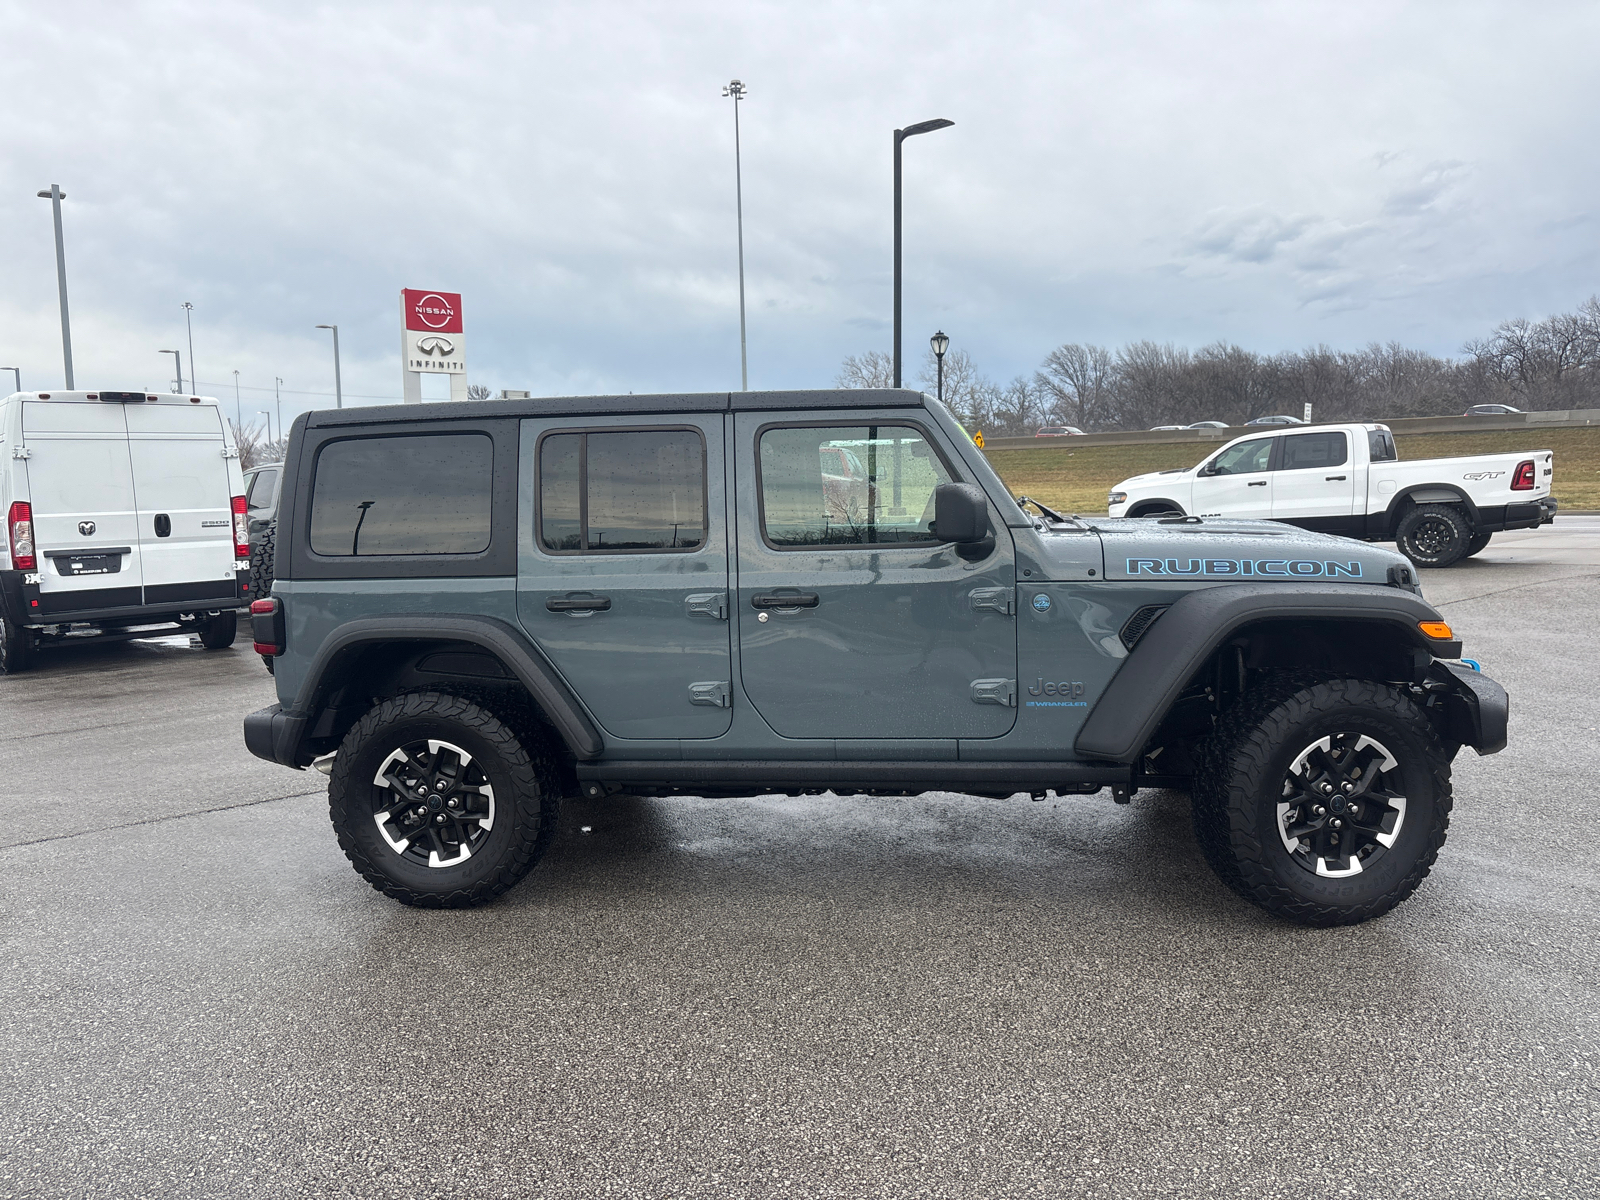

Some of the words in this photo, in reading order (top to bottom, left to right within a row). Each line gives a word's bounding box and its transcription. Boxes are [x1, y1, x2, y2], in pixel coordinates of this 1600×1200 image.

[415, 306, 454, 316] NISSAN
[410, 359, 463, 370] INFINITI
[1126, 557, 1363, 578] RUBICON
[1028, 677, 1085, 699] Jeep
